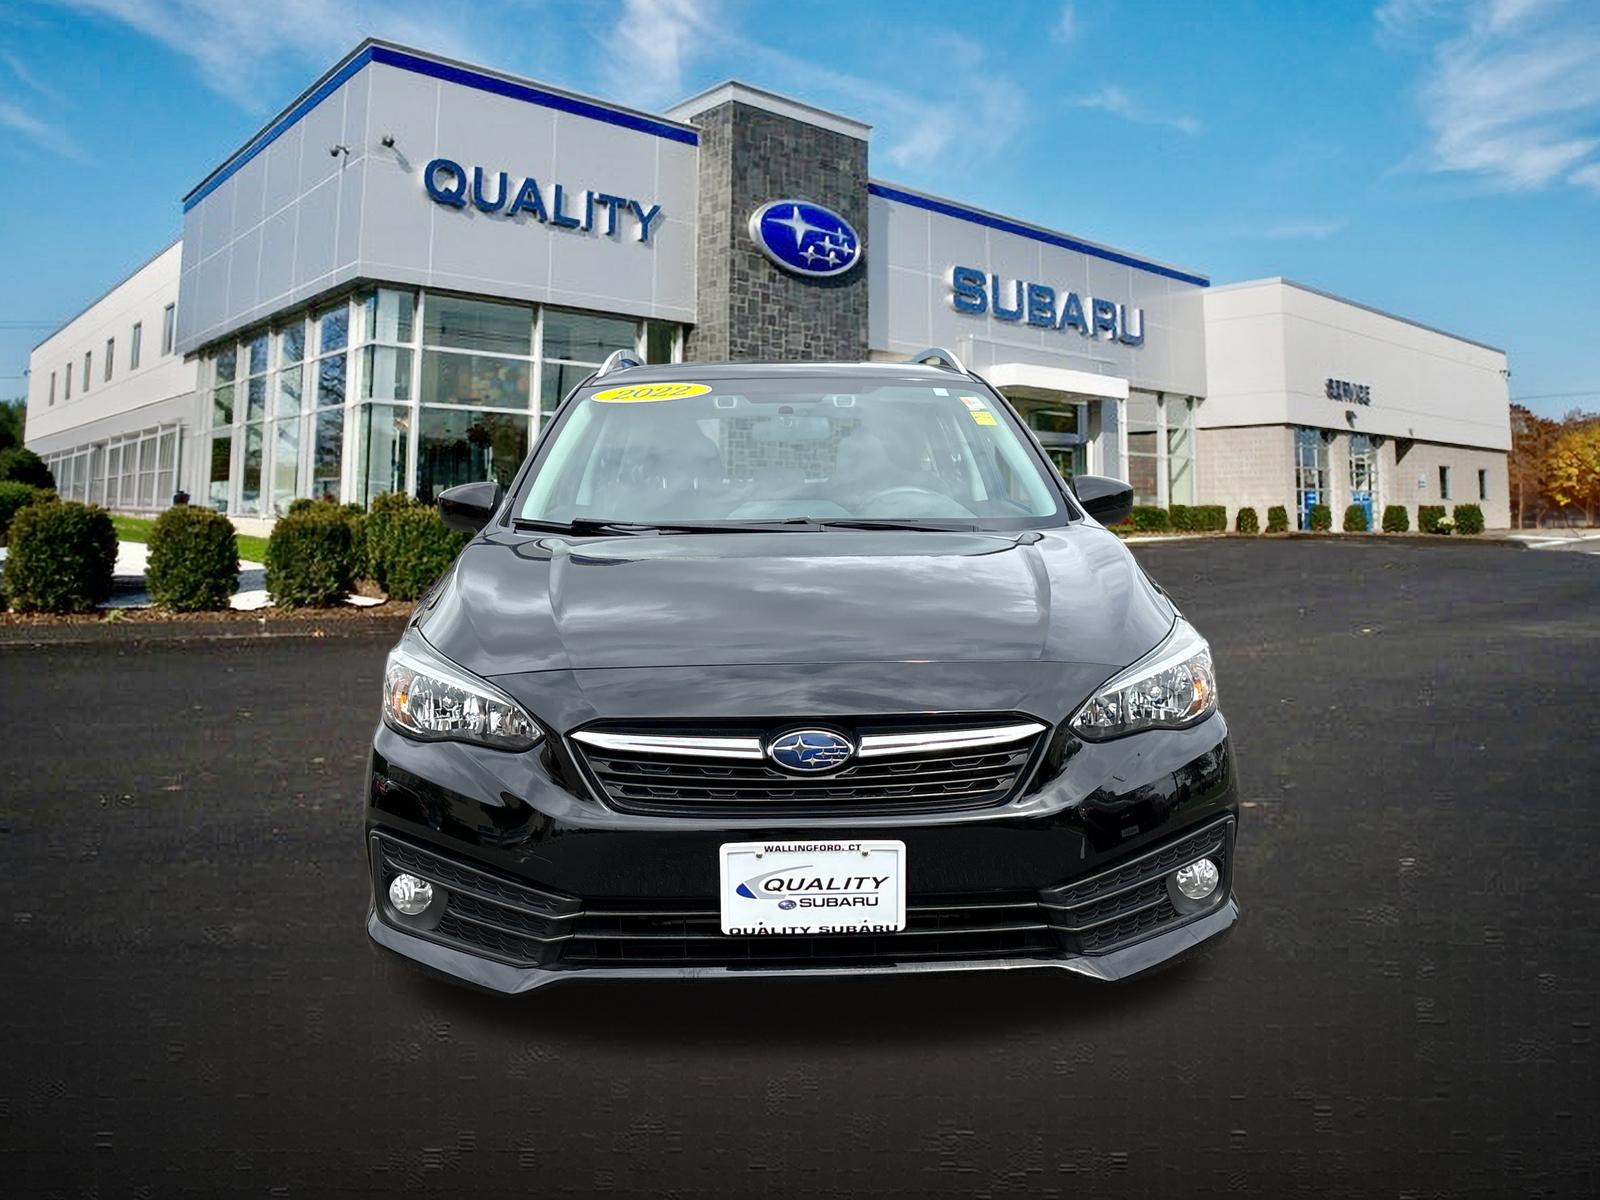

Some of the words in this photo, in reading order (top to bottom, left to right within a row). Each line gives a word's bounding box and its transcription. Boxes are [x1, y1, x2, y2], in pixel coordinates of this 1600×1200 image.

[424, 158, 661, 242] QUALITY
[950, 265, 1144, 346] SUBARU
[611, 385, 692, 400] 2022
[1326, 378, 1370, 406] SERVICE
[764, 876, 891, 892] QUALITY
[799, 896, 879, 908] SUBARU
[729, 926, 811, 935] QUALITY
[818, 924, 898, 934] SUBARU
